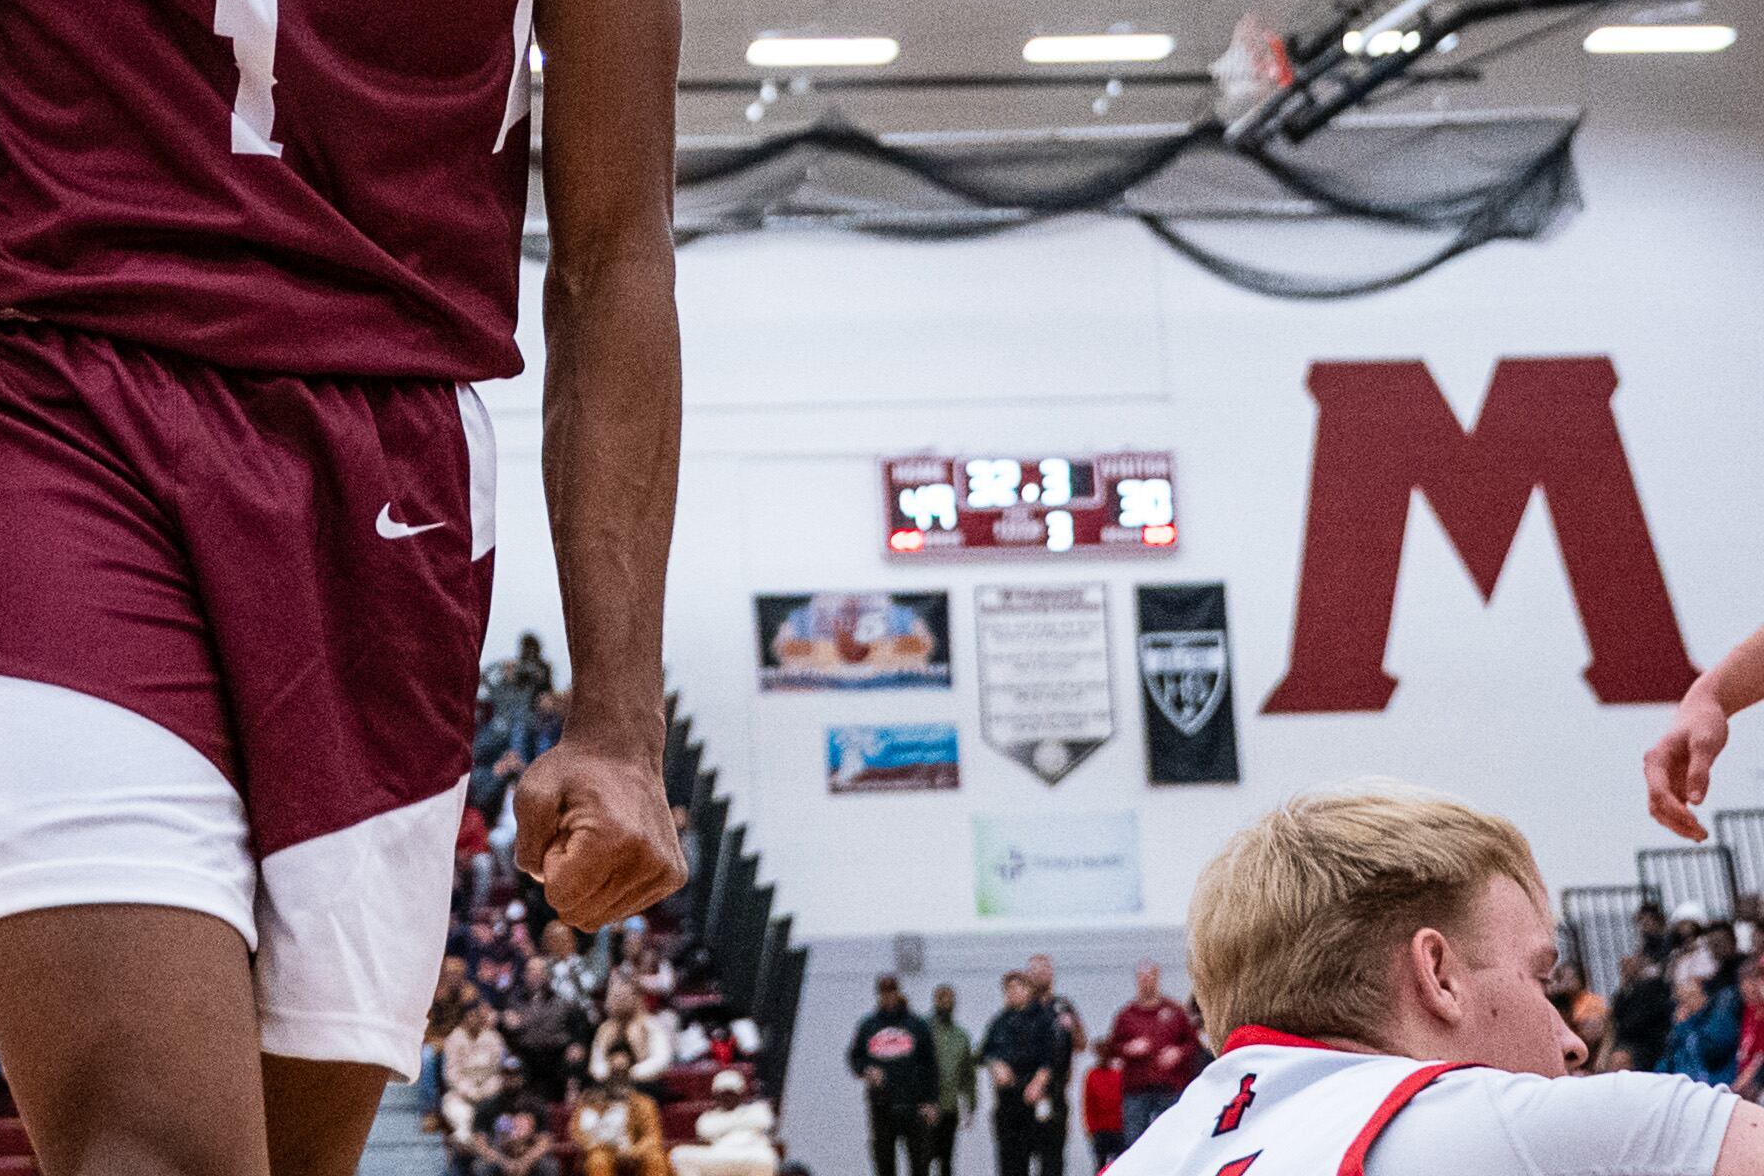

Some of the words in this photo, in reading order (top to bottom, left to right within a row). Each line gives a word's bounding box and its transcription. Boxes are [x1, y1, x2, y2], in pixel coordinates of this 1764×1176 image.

[899, 483, 957, 531] 49
[1117, 479, 1173, 528] 30
[1258, 355, 1703, 715] M
